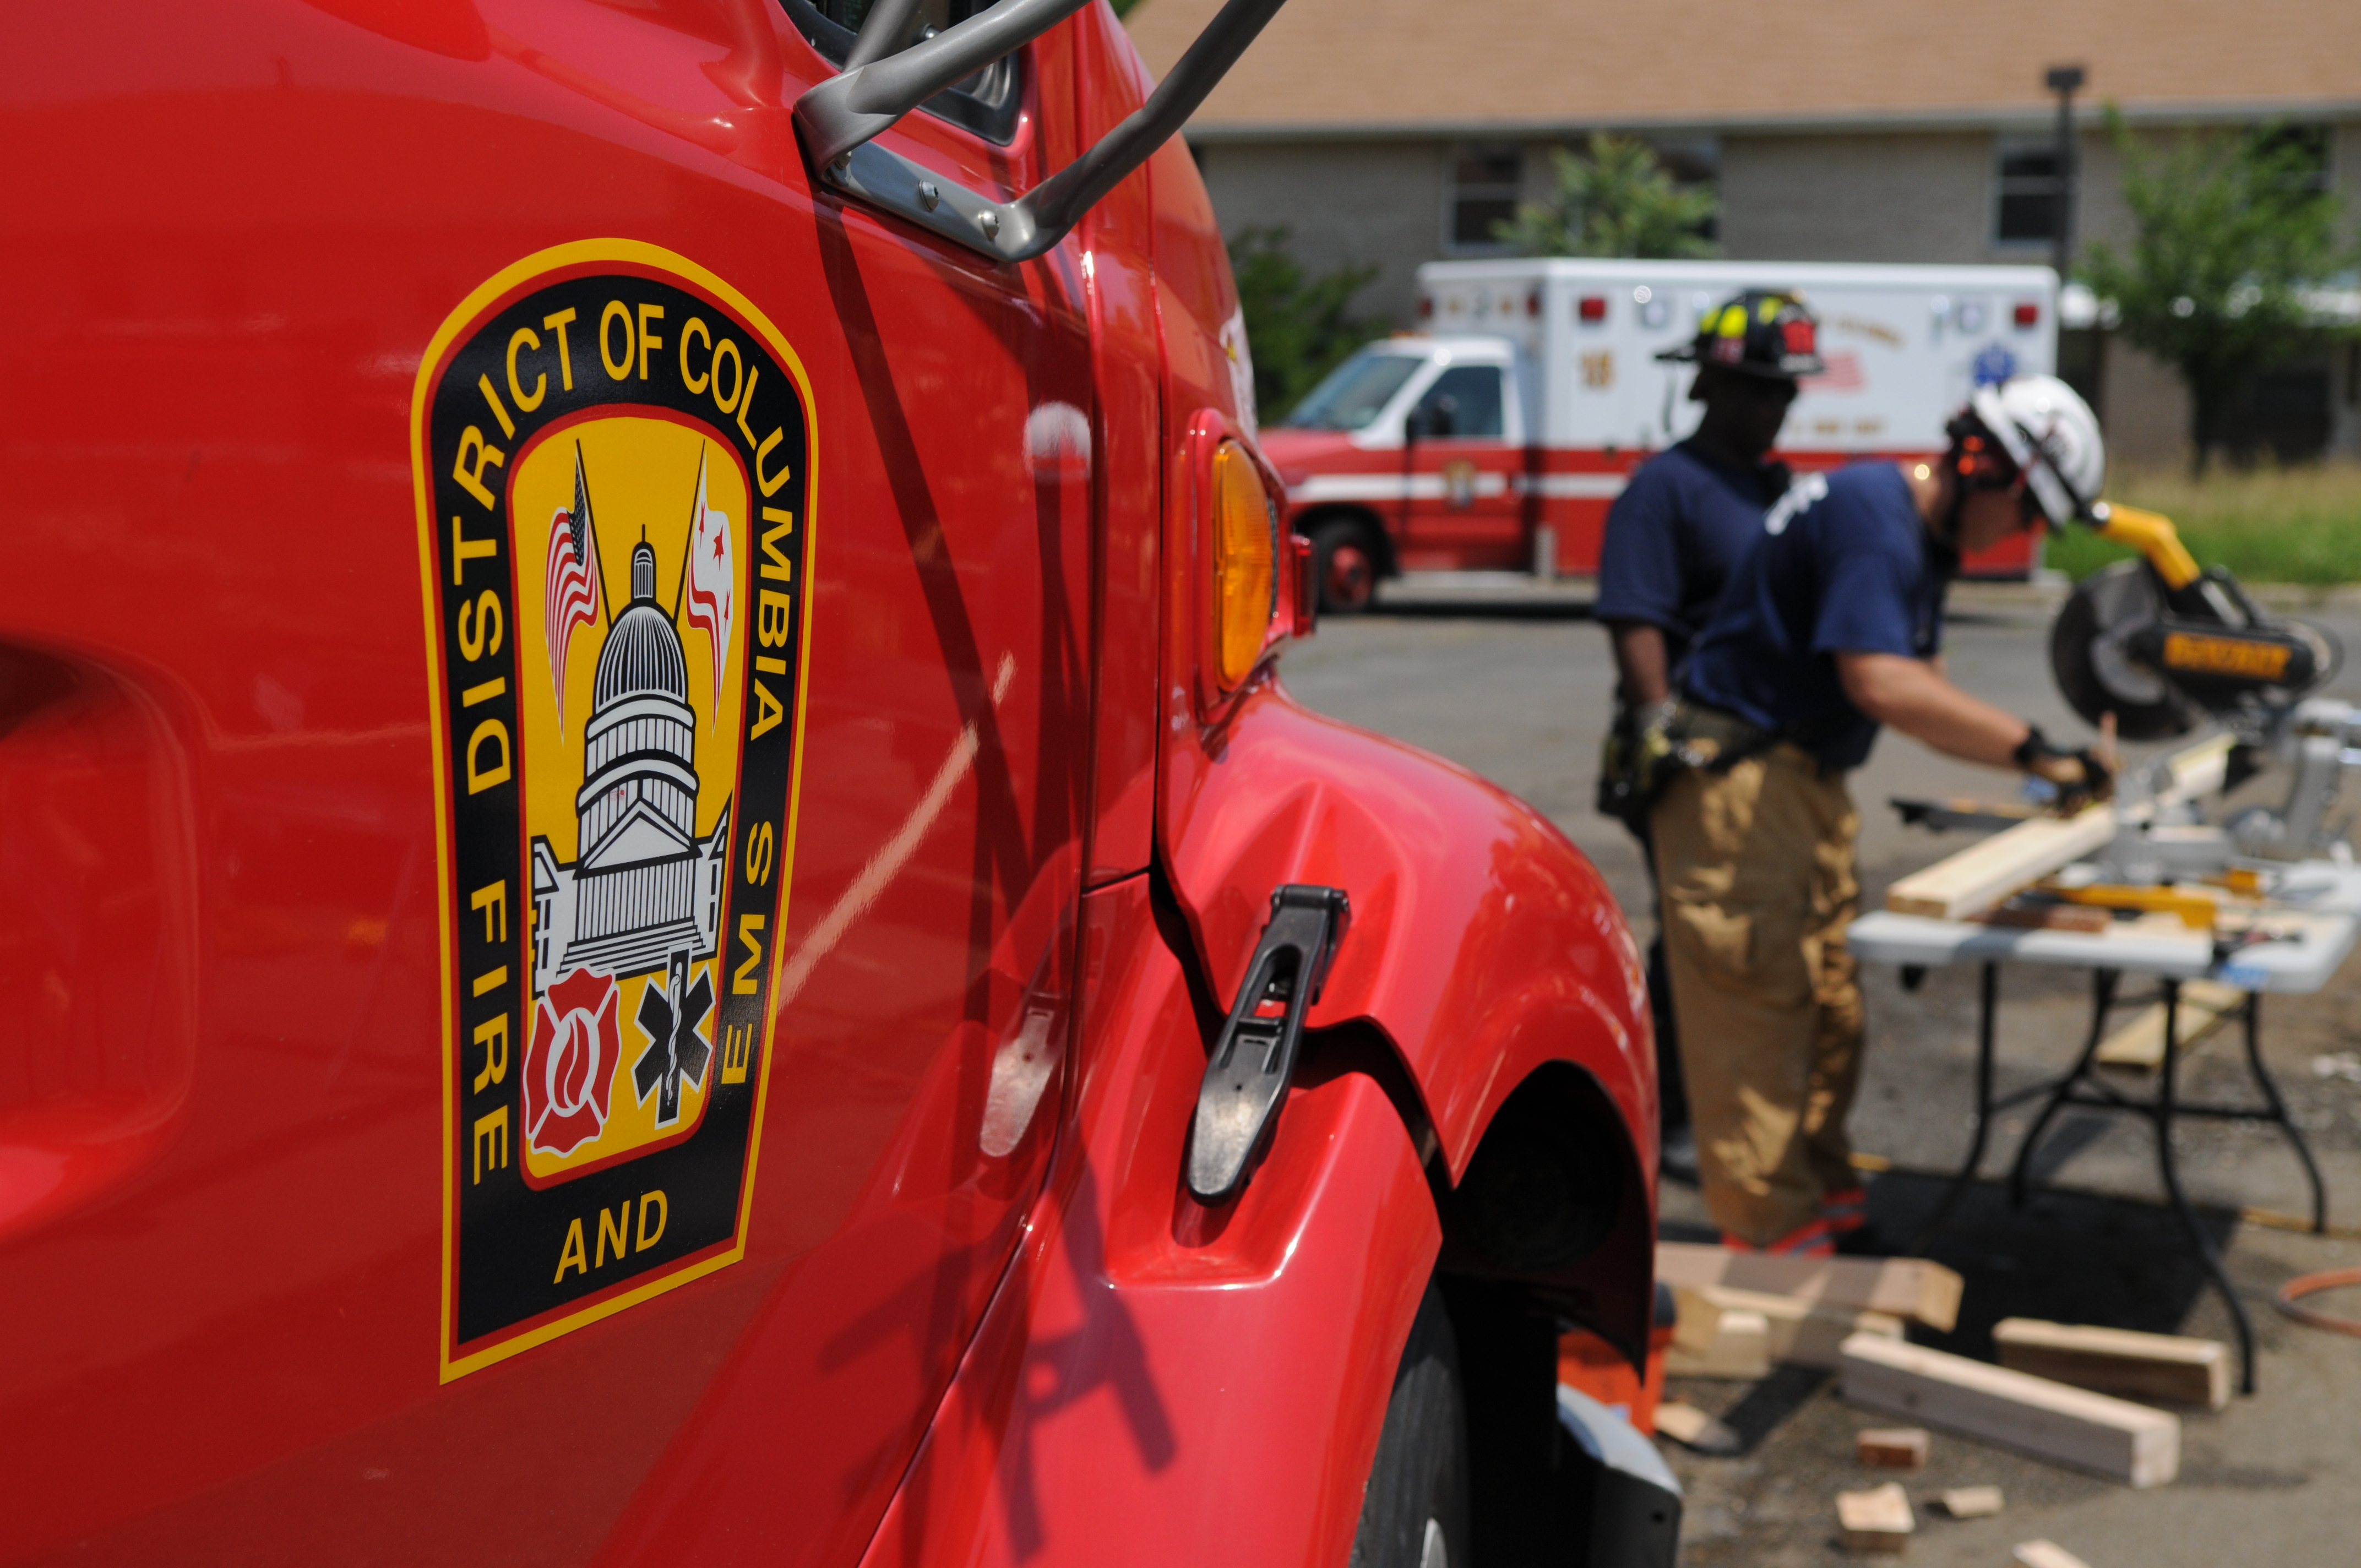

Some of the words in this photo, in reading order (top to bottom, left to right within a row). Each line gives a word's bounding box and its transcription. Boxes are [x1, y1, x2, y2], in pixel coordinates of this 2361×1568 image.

[453, 307, 576, 795] DISTRICT
[600, 300, 664, 381] OF
[679, 317, 792, 741] COLUMBIA
[471, 879, 508, 1185] FIRE
[553, 1190, 667, 1284] AND
[721, 821, 773, 1085] EMS
